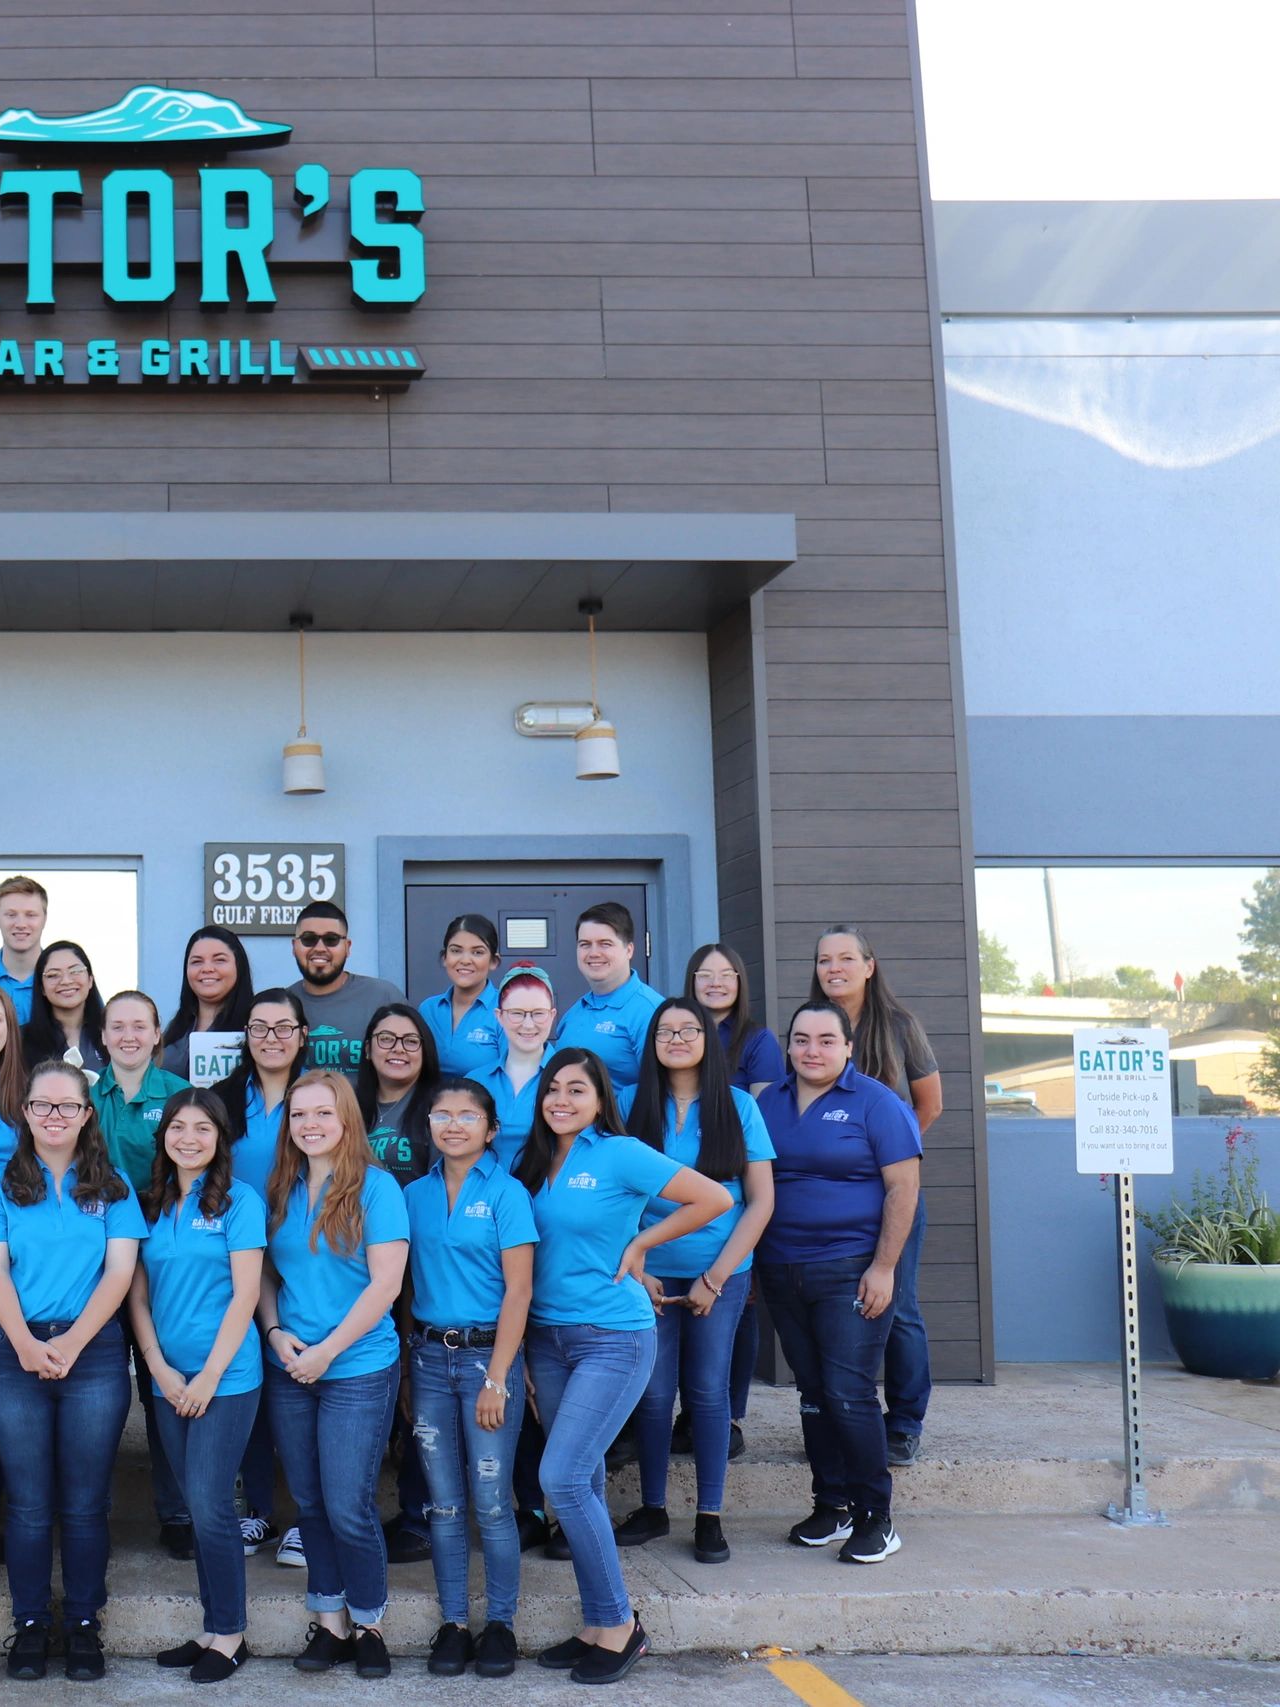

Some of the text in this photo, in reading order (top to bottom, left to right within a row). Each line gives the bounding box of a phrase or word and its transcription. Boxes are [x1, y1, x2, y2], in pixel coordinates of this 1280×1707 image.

[87, 340, 120, 377] &
[141, 339, 296, 376] GRILL
[213, 853, 337, 902] 3535
[213, 905, 306, 925] GULF FREE
[1080, 1049, 1164, 1071] GATOR'S
[1087, 1091, 1159, 1103] Curbside Pick-up &
[1098, 1107, 1150, 1118] Take-out only
[1089, 1125, 1159, 1134] Call 832-340-7016
[1087, 1143, 1099, 1151] you
[1156, 1142, 1168, 1150] out
